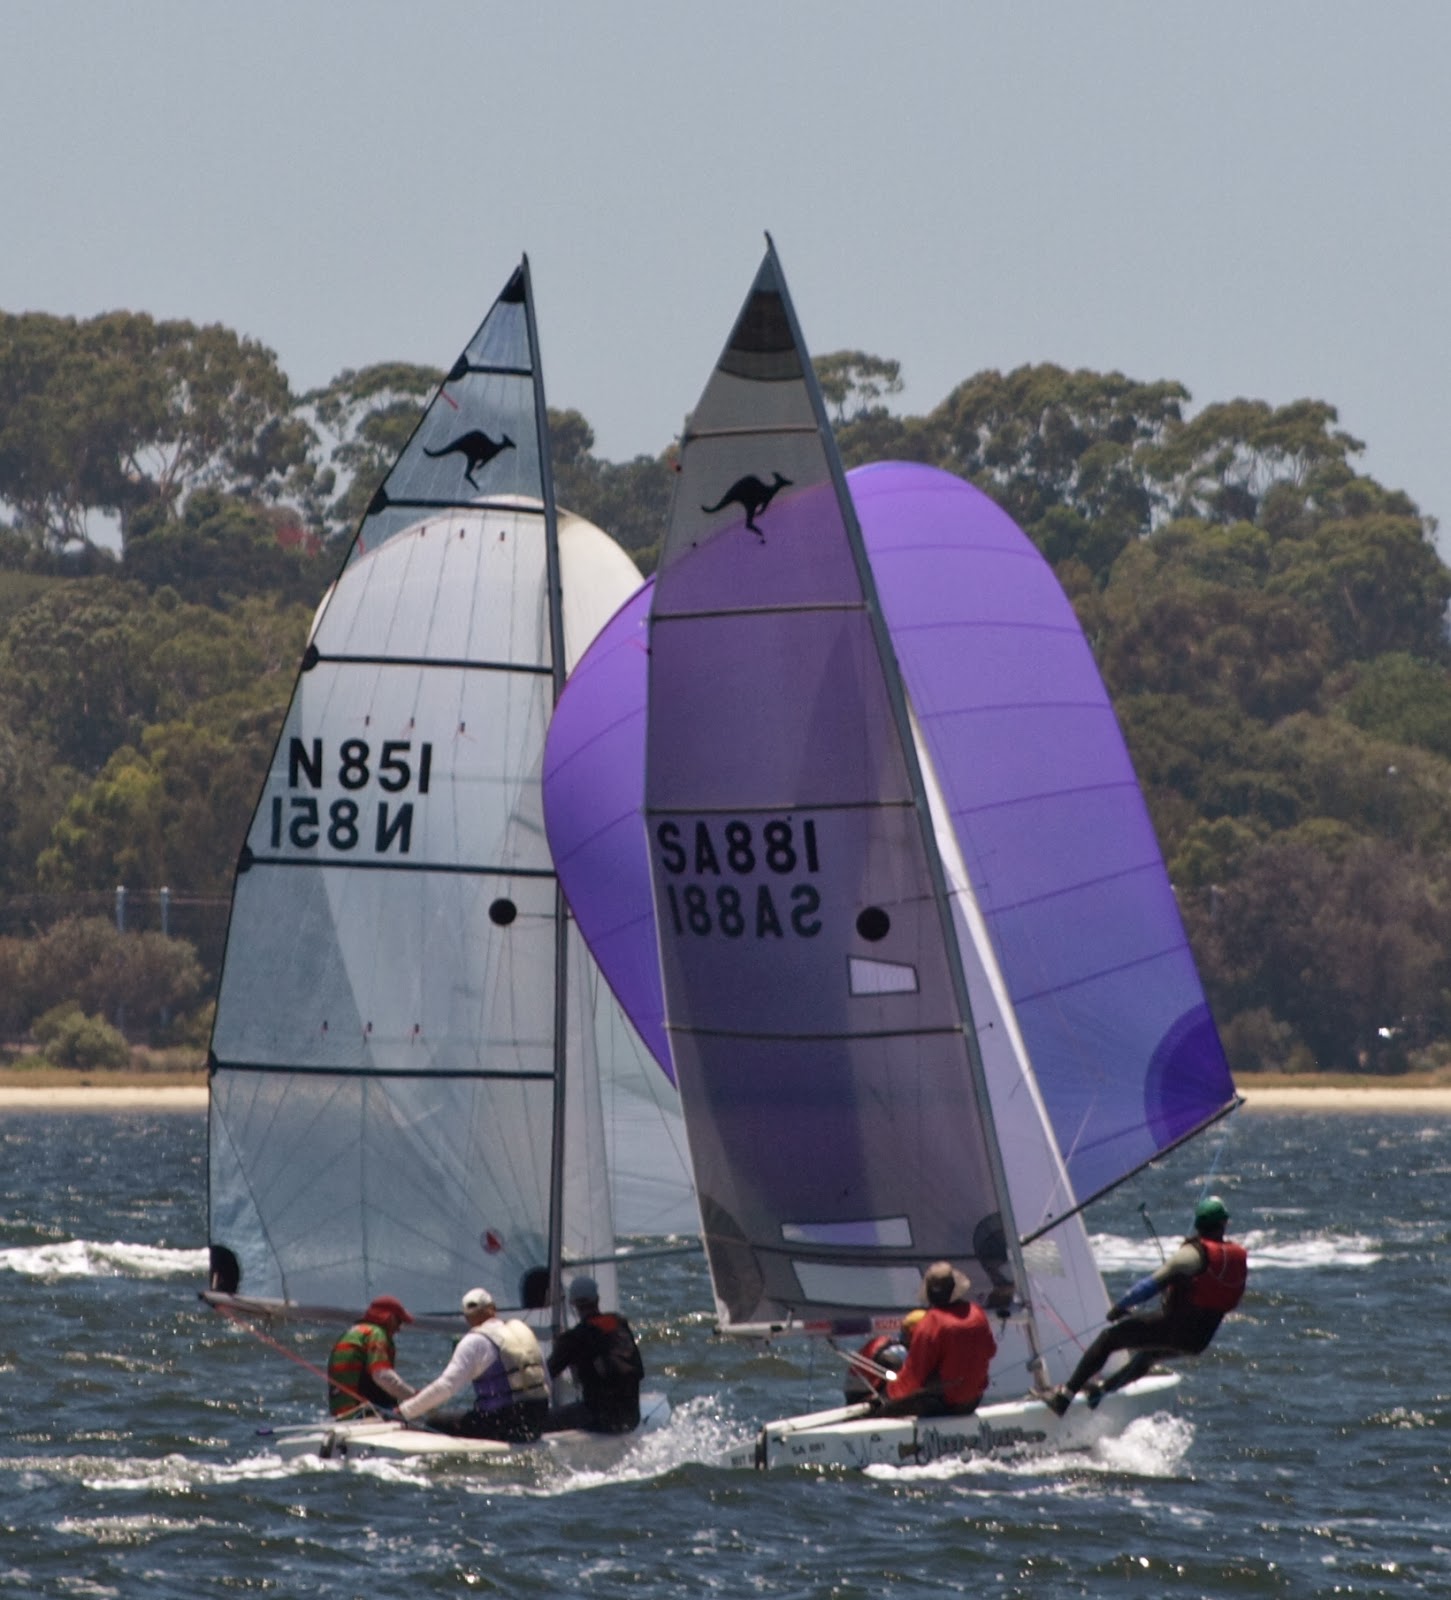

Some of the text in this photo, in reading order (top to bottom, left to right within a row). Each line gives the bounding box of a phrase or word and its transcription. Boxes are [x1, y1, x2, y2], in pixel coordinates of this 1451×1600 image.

[289, 737, 433, 794] N 851
[657, 820, 820, 875] SA881
